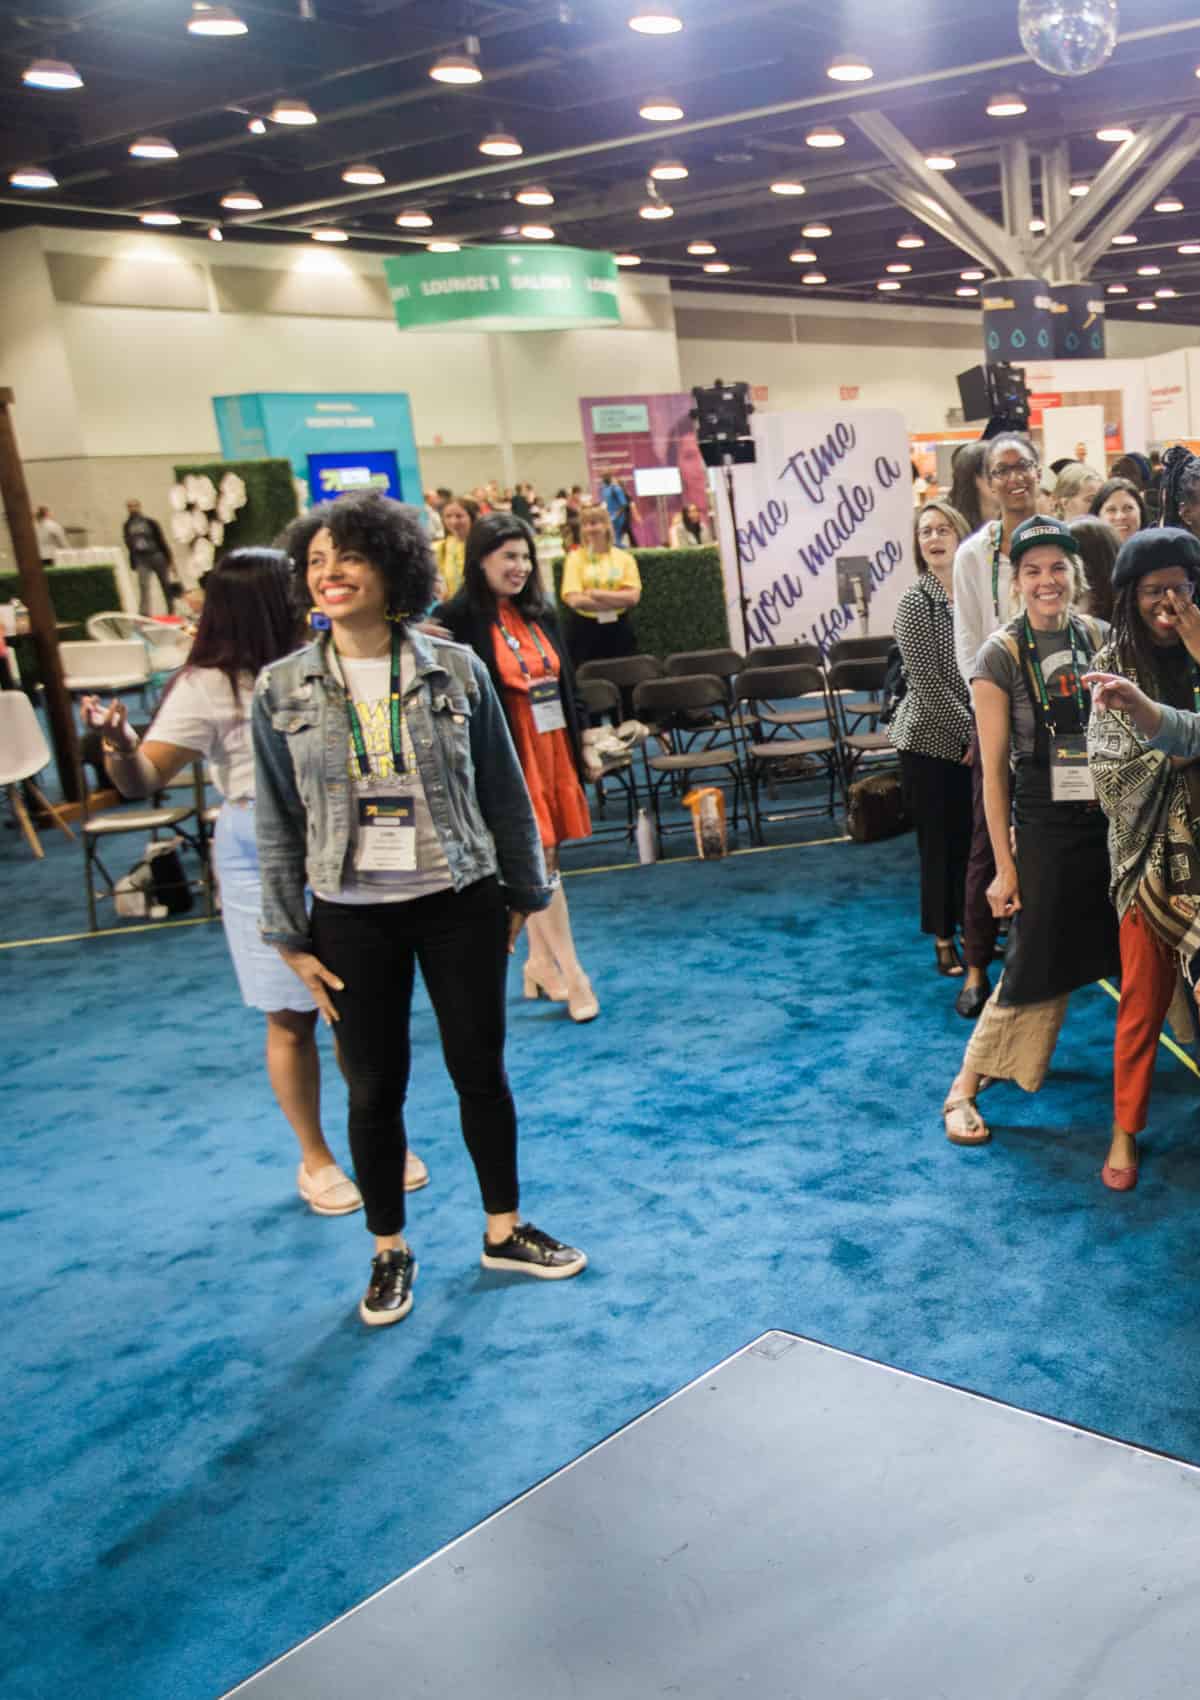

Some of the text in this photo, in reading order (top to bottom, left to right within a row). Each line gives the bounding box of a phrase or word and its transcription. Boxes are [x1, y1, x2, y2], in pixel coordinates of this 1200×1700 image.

[736, 422, 856, 563] one Time
[745, 455, 901, 647] you made a
